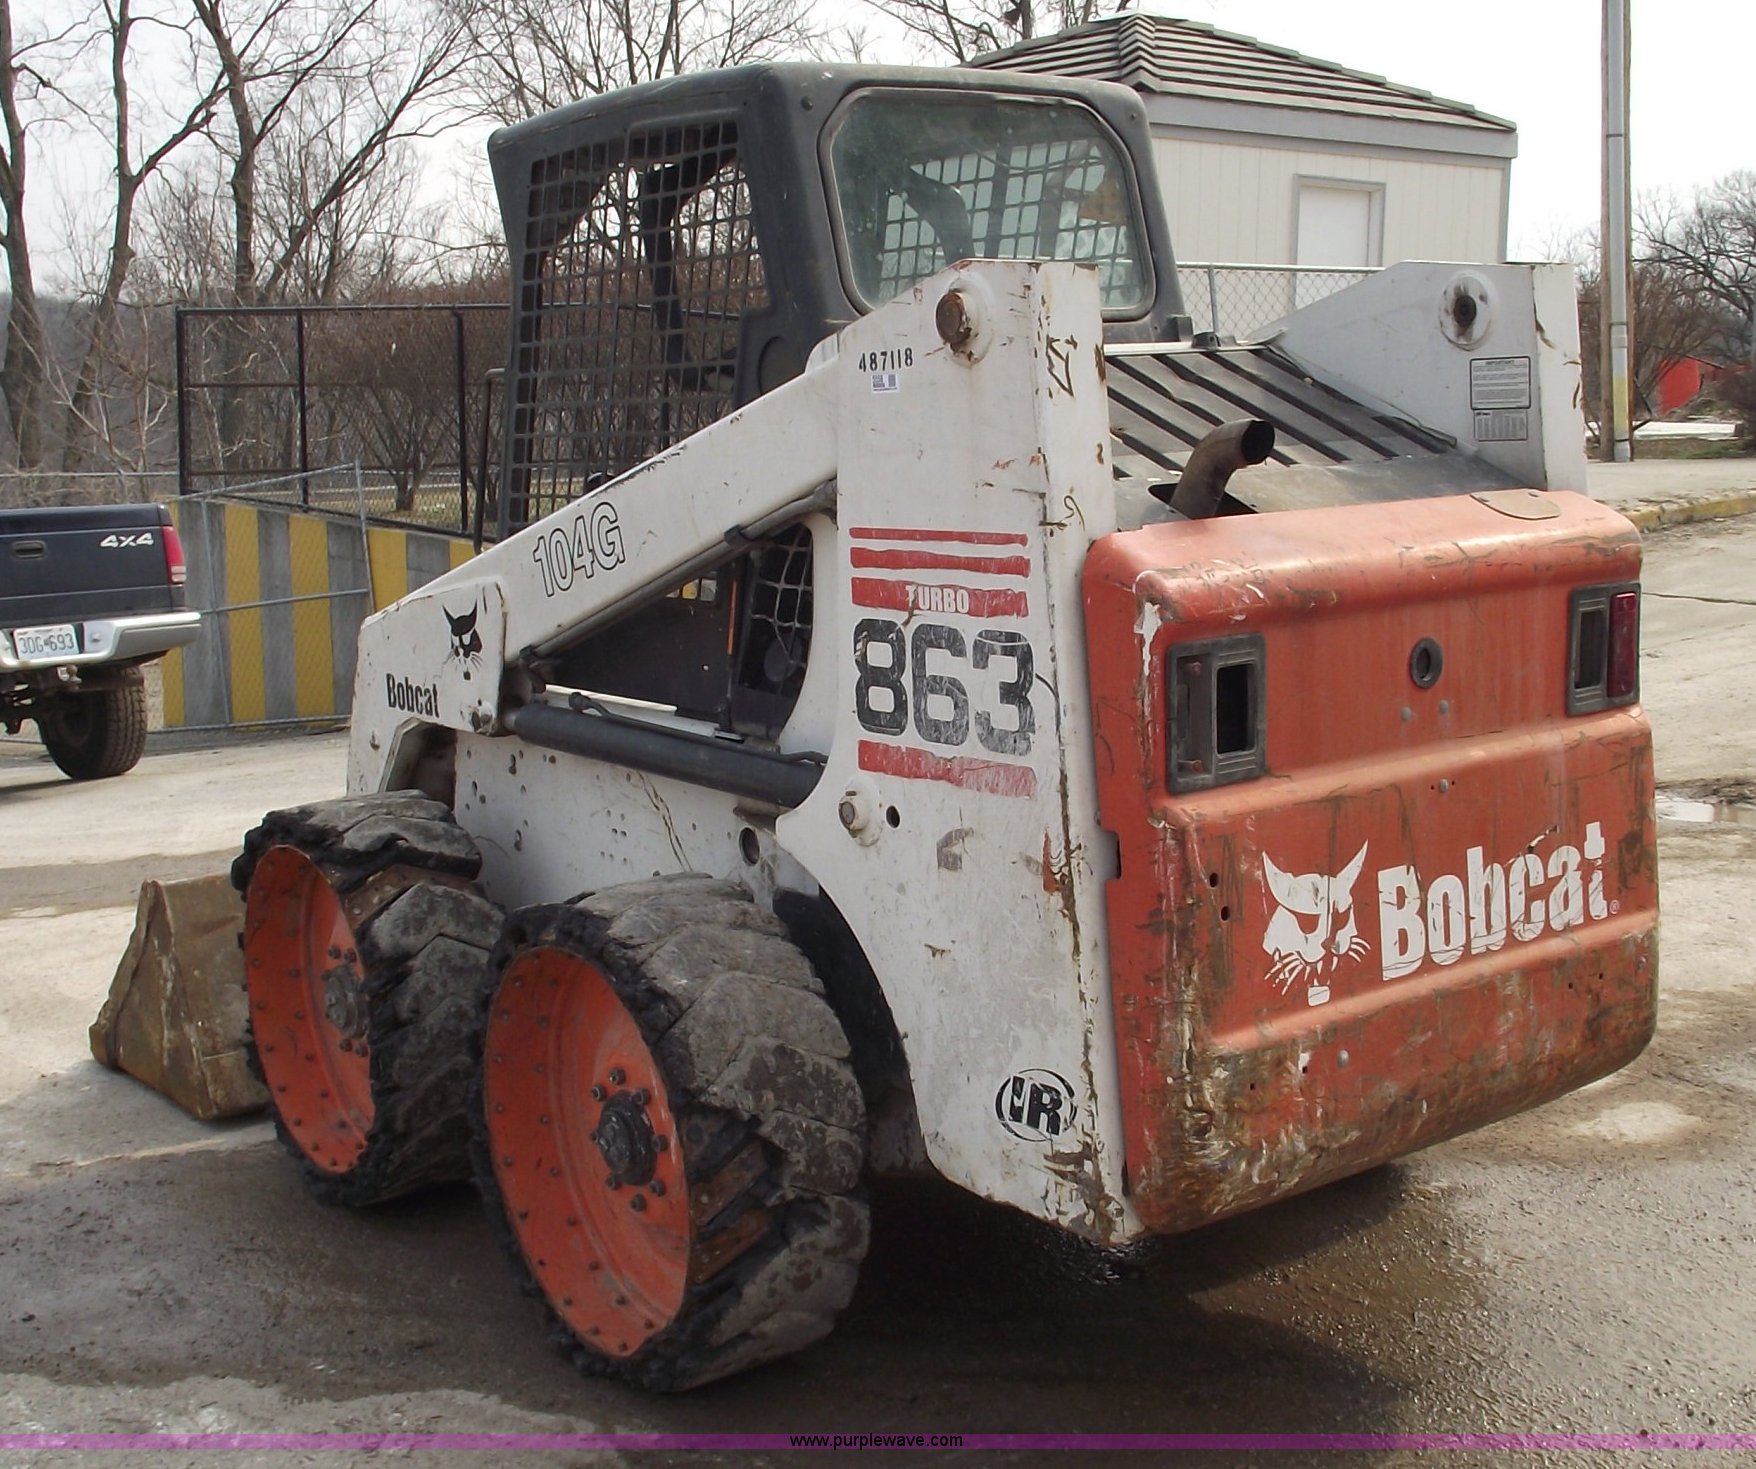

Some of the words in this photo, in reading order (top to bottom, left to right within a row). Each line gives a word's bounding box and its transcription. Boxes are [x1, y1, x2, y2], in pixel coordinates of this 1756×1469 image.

[859, 347, 913, 372] 487118
[533, 501, 626, 597] 104G
[905, 585, 970, 614] TURBO
[386, 673, 440, 719] Bobcat
[853, 618, 1036, 757] 863
[1377, 821, 1608, 981] Bobcat
